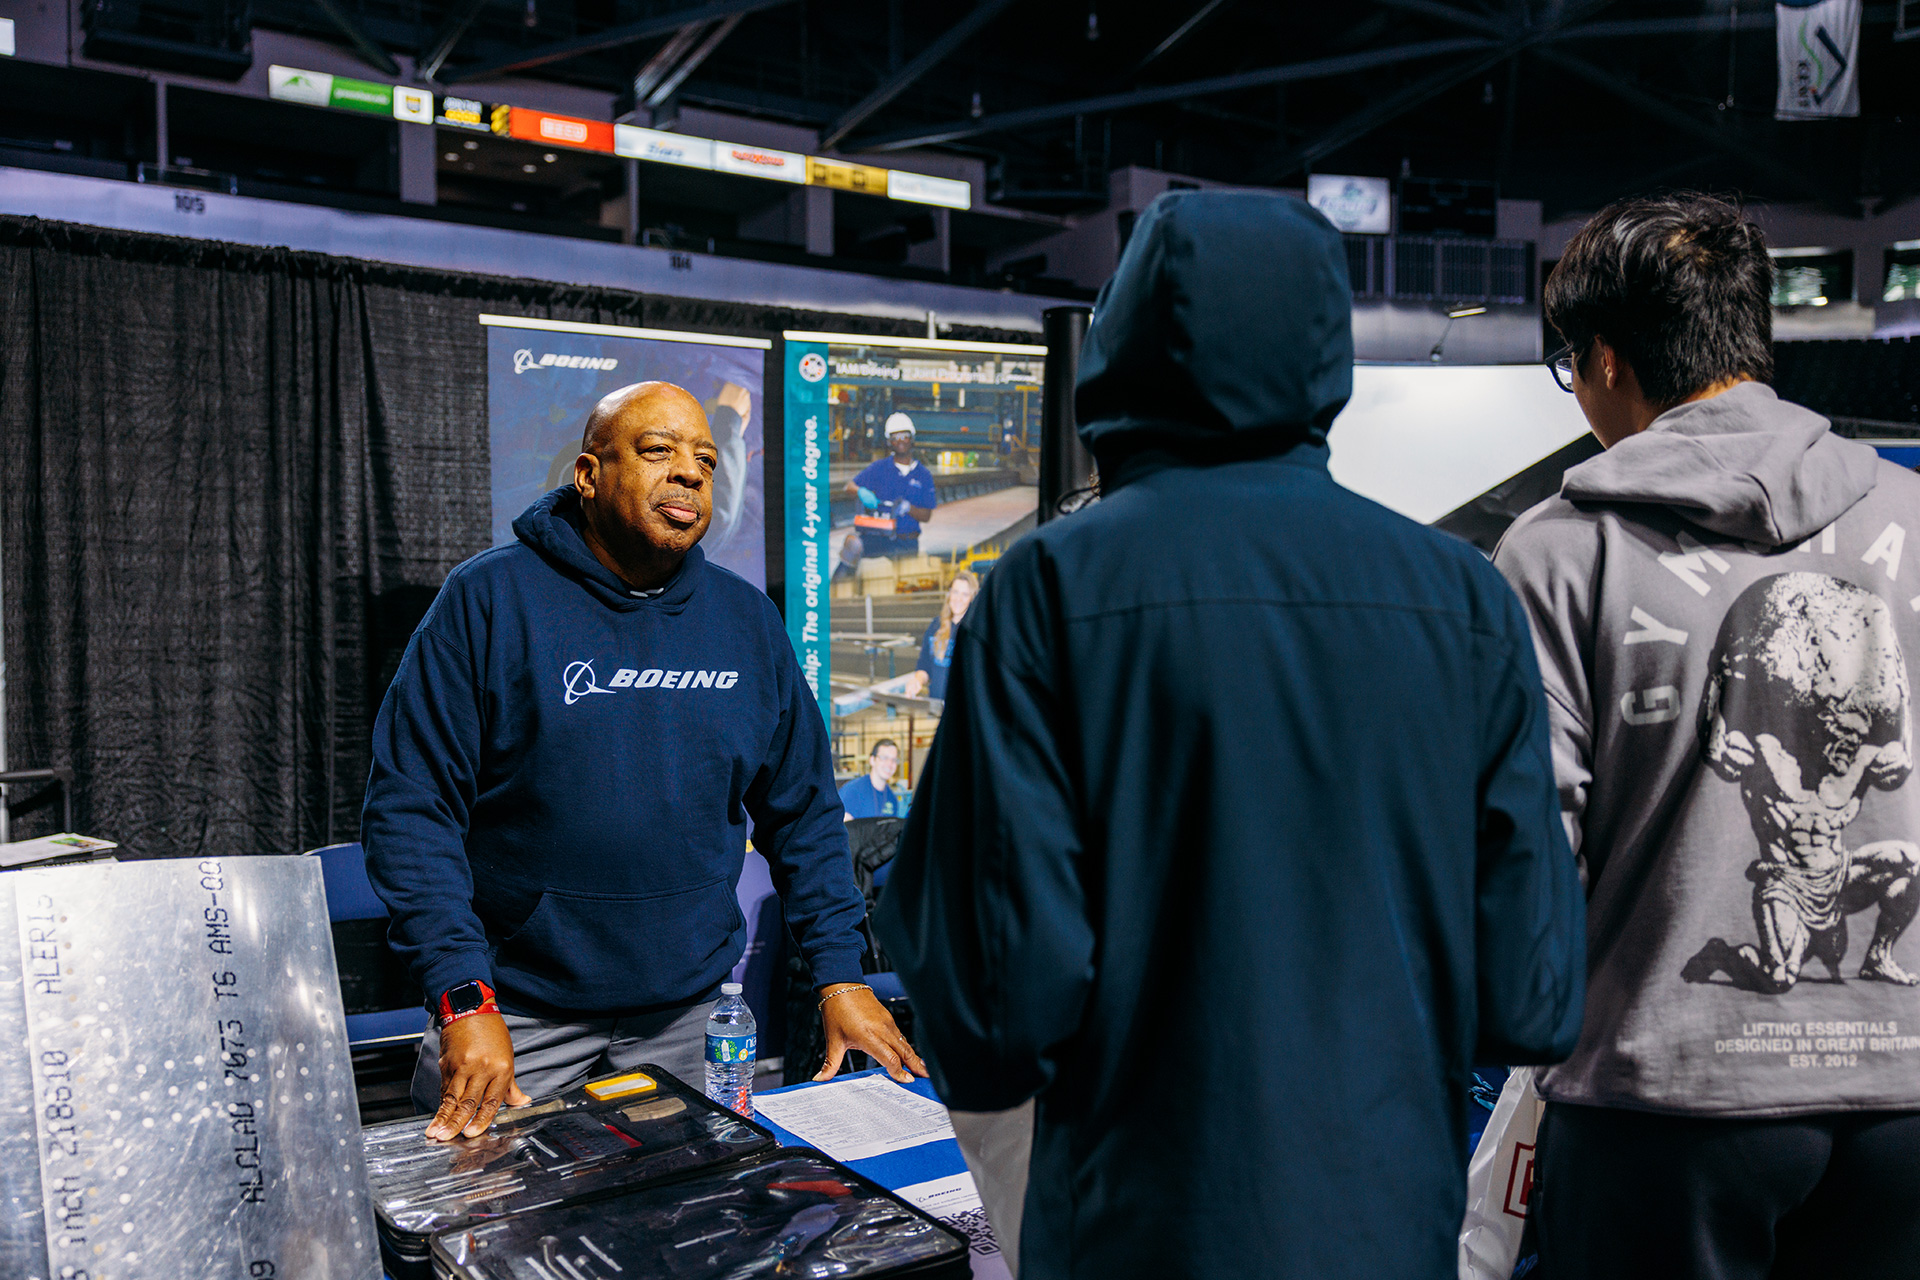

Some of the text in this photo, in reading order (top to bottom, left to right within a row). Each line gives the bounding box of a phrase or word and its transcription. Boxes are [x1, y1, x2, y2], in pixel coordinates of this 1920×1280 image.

[539, 353, 618, 371] BOEING
[802, 415, 822, 701] ship: The original 4-year degree.
[608, 668, 739, 689] BOEING
[212, 970, 239, 1001] T6
[1743, 1021, 1898, 1037] LIFTING ESSENTIALS
[1715, 1038, 1793, 1053] DESIGNED
[1796, 1038, 1812, 1052] IN
[1815, 1037, 1866, 1051] GREAT
[1789, 1053, 1858, 1068] EST. 2012
[230, 1103, 266, 1204] ALCLAD
